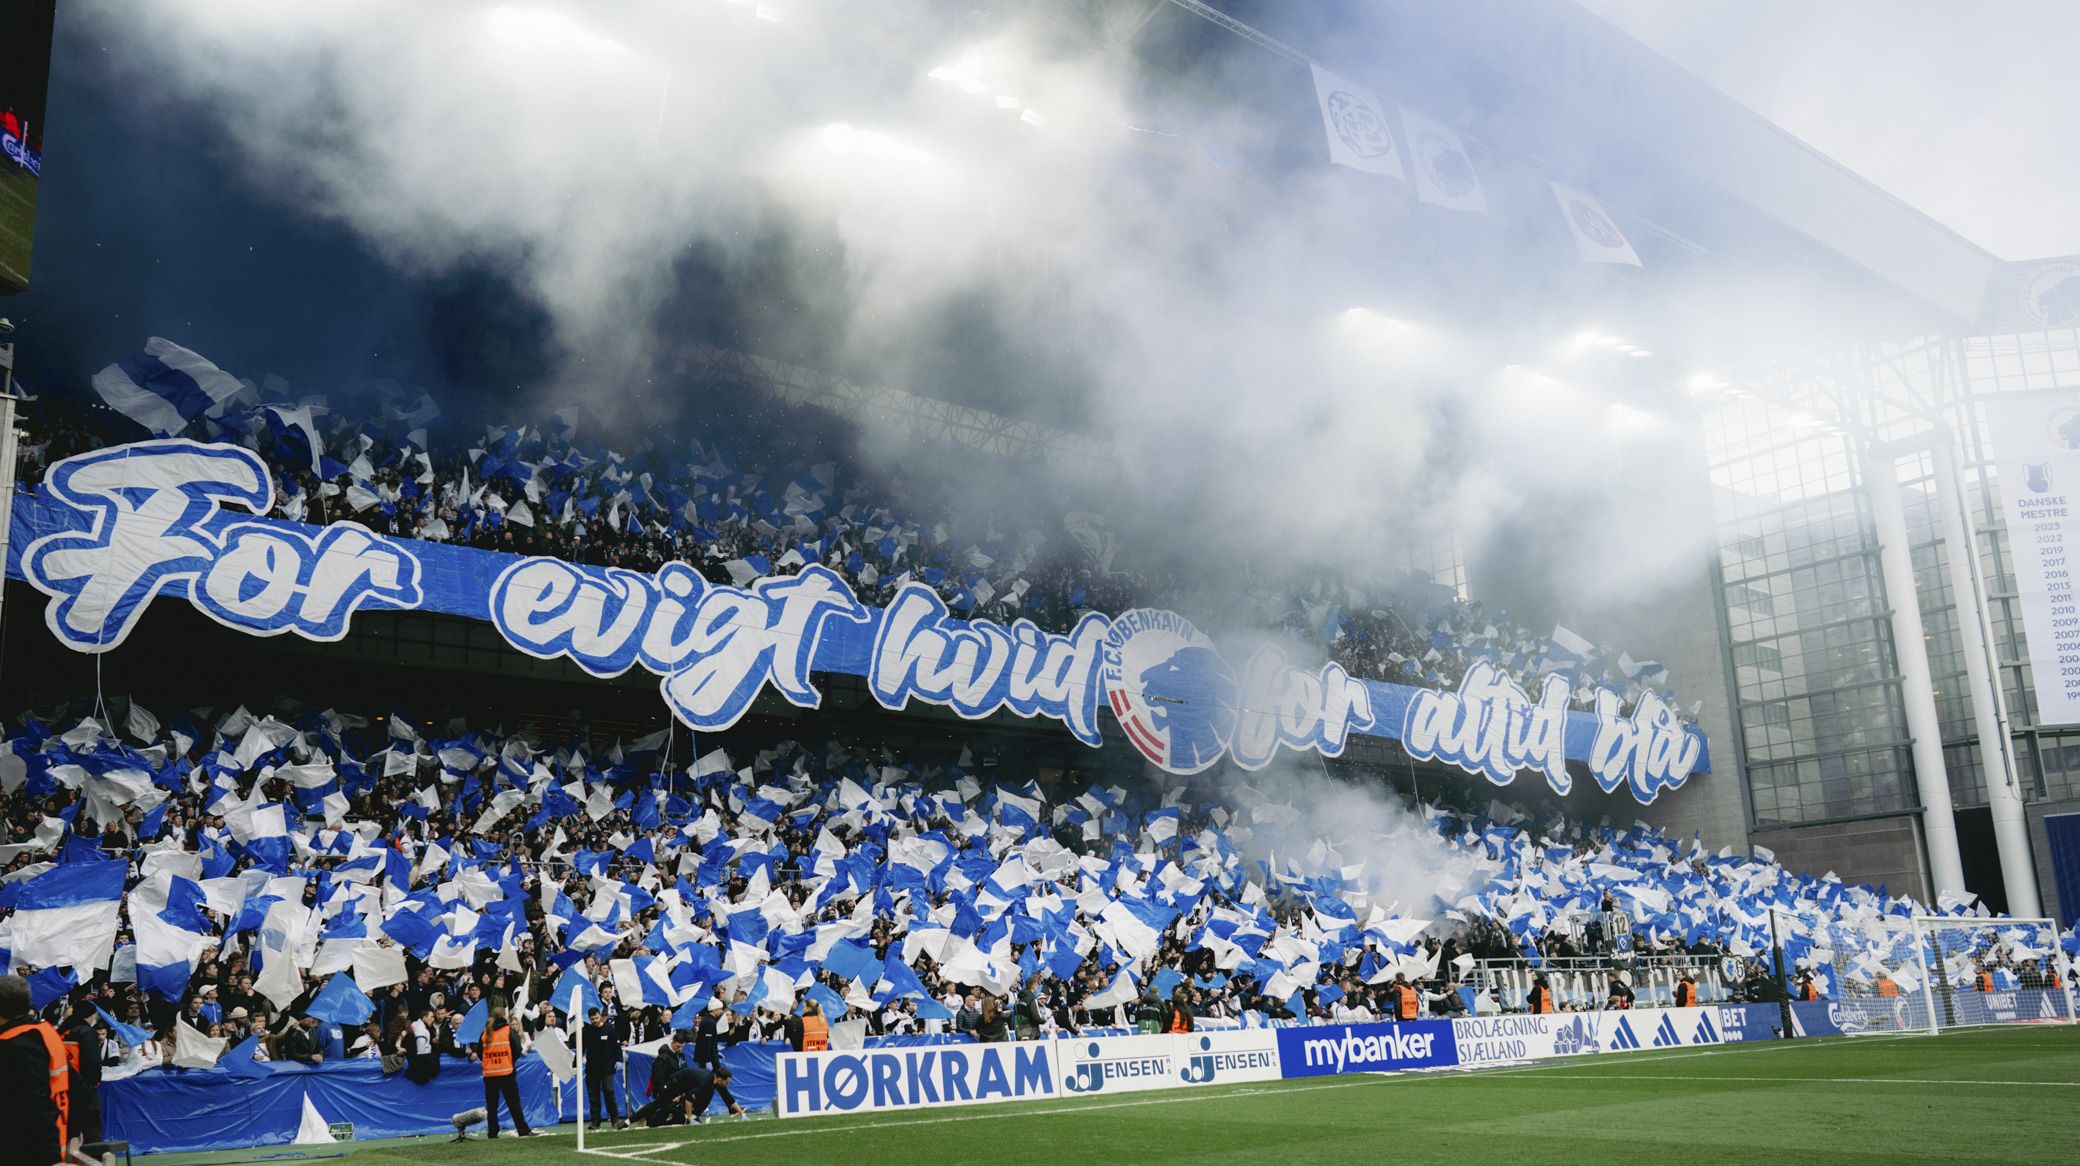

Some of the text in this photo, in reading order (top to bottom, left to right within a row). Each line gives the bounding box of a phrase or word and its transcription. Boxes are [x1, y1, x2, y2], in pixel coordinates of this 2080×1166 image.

[2017, 496, 2067, 508] DANSKE
[2020, 508, 2069, 519] MESTRE
[2034, 522, 2060, 532] 2023
[2036, 534, 2062, 544] 2022
[2040, 546, 2063, 556] 2019
[2042, 558, 2065, 567] 2017
[2044, 570, 2068, 579] 2016
[2046, 582, 2070, 591] 2013
[2050, 594, 2071, 603] 2011
[2051, 606, 2074, 615] 2010
[22, 438, 1700, 805] For evigt hvid for altid blå
[2052, 618, 2078, 627] 2009
[2054, 630, 2080, 639] 2007
[2058, 655, 2080, 664] 200
[1985, 993, 2017, 1010] UNIBET
[1828, 1003, 1868, 1030] Carlsberg
[1455, 1016, 1548, 1040] BROLÆGNING
[1304, 1024, 1434, 1074] mybanker
[1458, 1040, 1526, 1062] SJÆLLAND
[784, 1045, 1054, 1113] HØRKRAM
